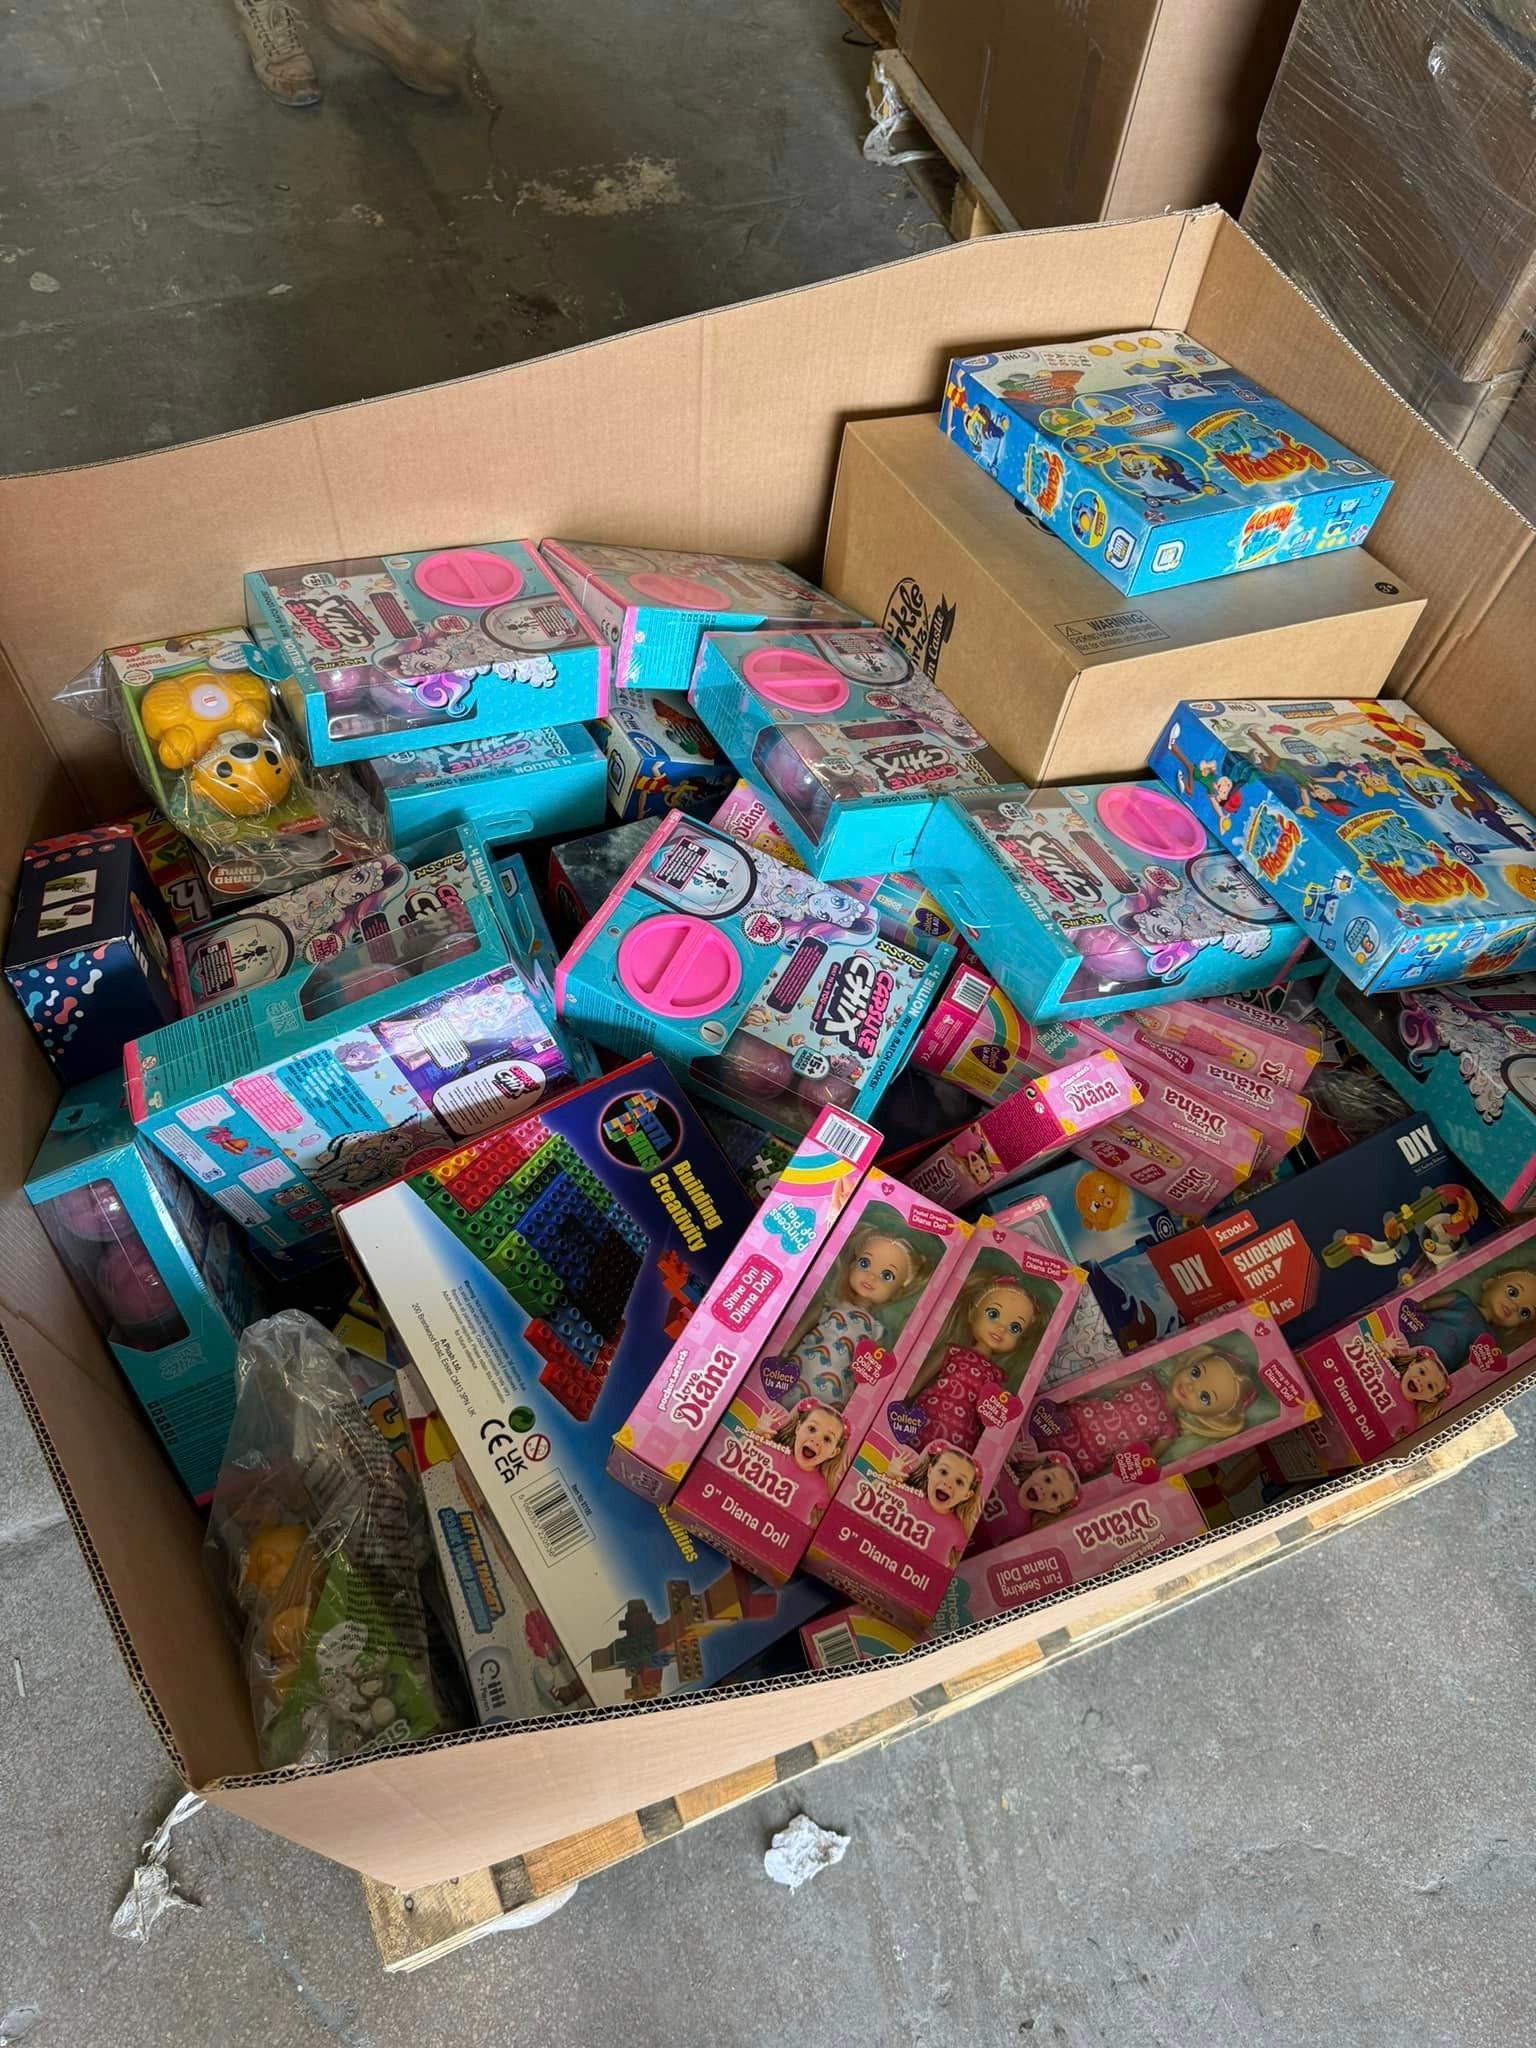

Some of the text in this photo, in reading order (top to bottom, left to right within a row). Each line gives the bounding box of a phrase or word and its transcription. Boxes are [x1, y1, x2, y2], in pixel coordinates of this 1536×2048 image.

[285, 603, 341, 651] CAPSULE
[1087, 612, 1147, 632] WARNING:
[282, 637, 304, 666] BILLION
[449, 740, 531, 773] CAPSULE
[515, 758, 559, 774] BILLION
[886, 764, 959, 789] CAPSULE
[733, 801, 765, 840] Diana
[469, 856, 494, 895] BILLION
[997, 838, 1073, 902] CAPSULE
[1015, 885, 1049, 921] BILLION
[929, 968, 939, 979] 4
[906, 977, 936, 1017] BILLION
[854, 971, 894, 1056] CAPSULE
[1225, 999, 1287, 1030] Diana
[804, 1053, 824, 1077] 15+
[1067, 1079, 1120, 1114] Diana
[1209, 1066, 1272, 1102] Diana
[1164, 1089, 1225, 1135] Diana
[1396, 1125, 1439, 1164] DIY
[911, 1159, 952, 1194] Diana
[1169, 1169, 1204, 1199] Diana
[672, 1160, 723, 1230] Building
[650, 1172, 707, 1253] Creativity
[778, 1202, 816, 1240] of play!
[911, 1214, 946, 1231] Diana Doll
[770, 1208, 808, 1251] Princess
[1216, 1221, 1251, 1242] SEDOLA
[1233, 1228, 1295, 1273] SLIDEWAY
[1025, 1260, 1060, 1277] Diana Doll
[1170, 1255, 1212, 1295] DIY
[1244, 1269, 1275, 1290] TOYS
[722, 1266, 759, 1310] Shine On!
[730, 1269, 774, 1324] Diana Doll
[411, 1302, 423, 1315] 200
[1270, 1301, 1279, 1316] 4
[1402, 1305, 1424, 1329] Collect
[416, 1313, 438, 1343] Brentwood
[439, 1337, 456, 1361] A Plush
[864, 1352, 882, 1370] Diana
[873, 1348, 886, 1359] 6
[1491, 1346, 1502, 1356] 6
[440, 1357, 456, 1376] Essex
[763, 1368, 794, 1383] Collect
[852, 1362, 876, 1385] Collect!
[857, 1356, 872, 1371] Dolls
[1343, 1336, 1395, 1414] Diana
[449, 1374, 465, 1393] CM13
[659, 1350, 688, 1411] pocket.watch
[673, 1348, 737, 1428] Diana
[680, 1372, 703, 1400] Love,
[766, 1379, 789, 1391] Us All!
[1263, 1367, 1293, 1403] Diana Doll
[458, 1390, 472, 1406] 3PN
[982, 1400, 998, 1415] Dolls
[990, 1396, 1008, 1414] Diana
[998, 1392, 1010, 1403] 6
[1334, 1378, 1357, 1415] Diana
[1355, 1415, 1376, 1441] Doll
[466, 1406, 477, 1418] UK
[890, 1411, 922, 1427] Collect
[1036, 1406, 1061, 1433] Collect
[475, 1414, 515, 1456] CE
[893, 1422, 917, 1434] Us All!
[505, 1448, 529, 1476] UK
[743, 1441, 770, 1469] Love,
[1140, 1456, 1156, 1468] 6
[492, 1455, 517, 1485] CA
[719, 1441, 794, 1504] Diana
[877, 1485, 905, 1512] Love,
[459, 1512, 476, 1538] HIT
[721, 1496, 758, 1529] Diana
[761, 1521, 790, 1548] Doll
[855, 1484, 930, 1547] Diana
[1074, 1501, 1158, 1549] Diana
[441, 1508, 462, 1545] SOAK
[453, 1544, 474, 1581] YOUR
[467, 1537, 486, 1564] THE
[859, 1538, 897, 1572] Diana
[901, 1564, 930, 1591] Doll
[996, 1555, 1058, 1585] Diana Doll
[1001, 1570, 1062, 1598] Fun Seeking
[479, 1687, 493, 1712] Players
